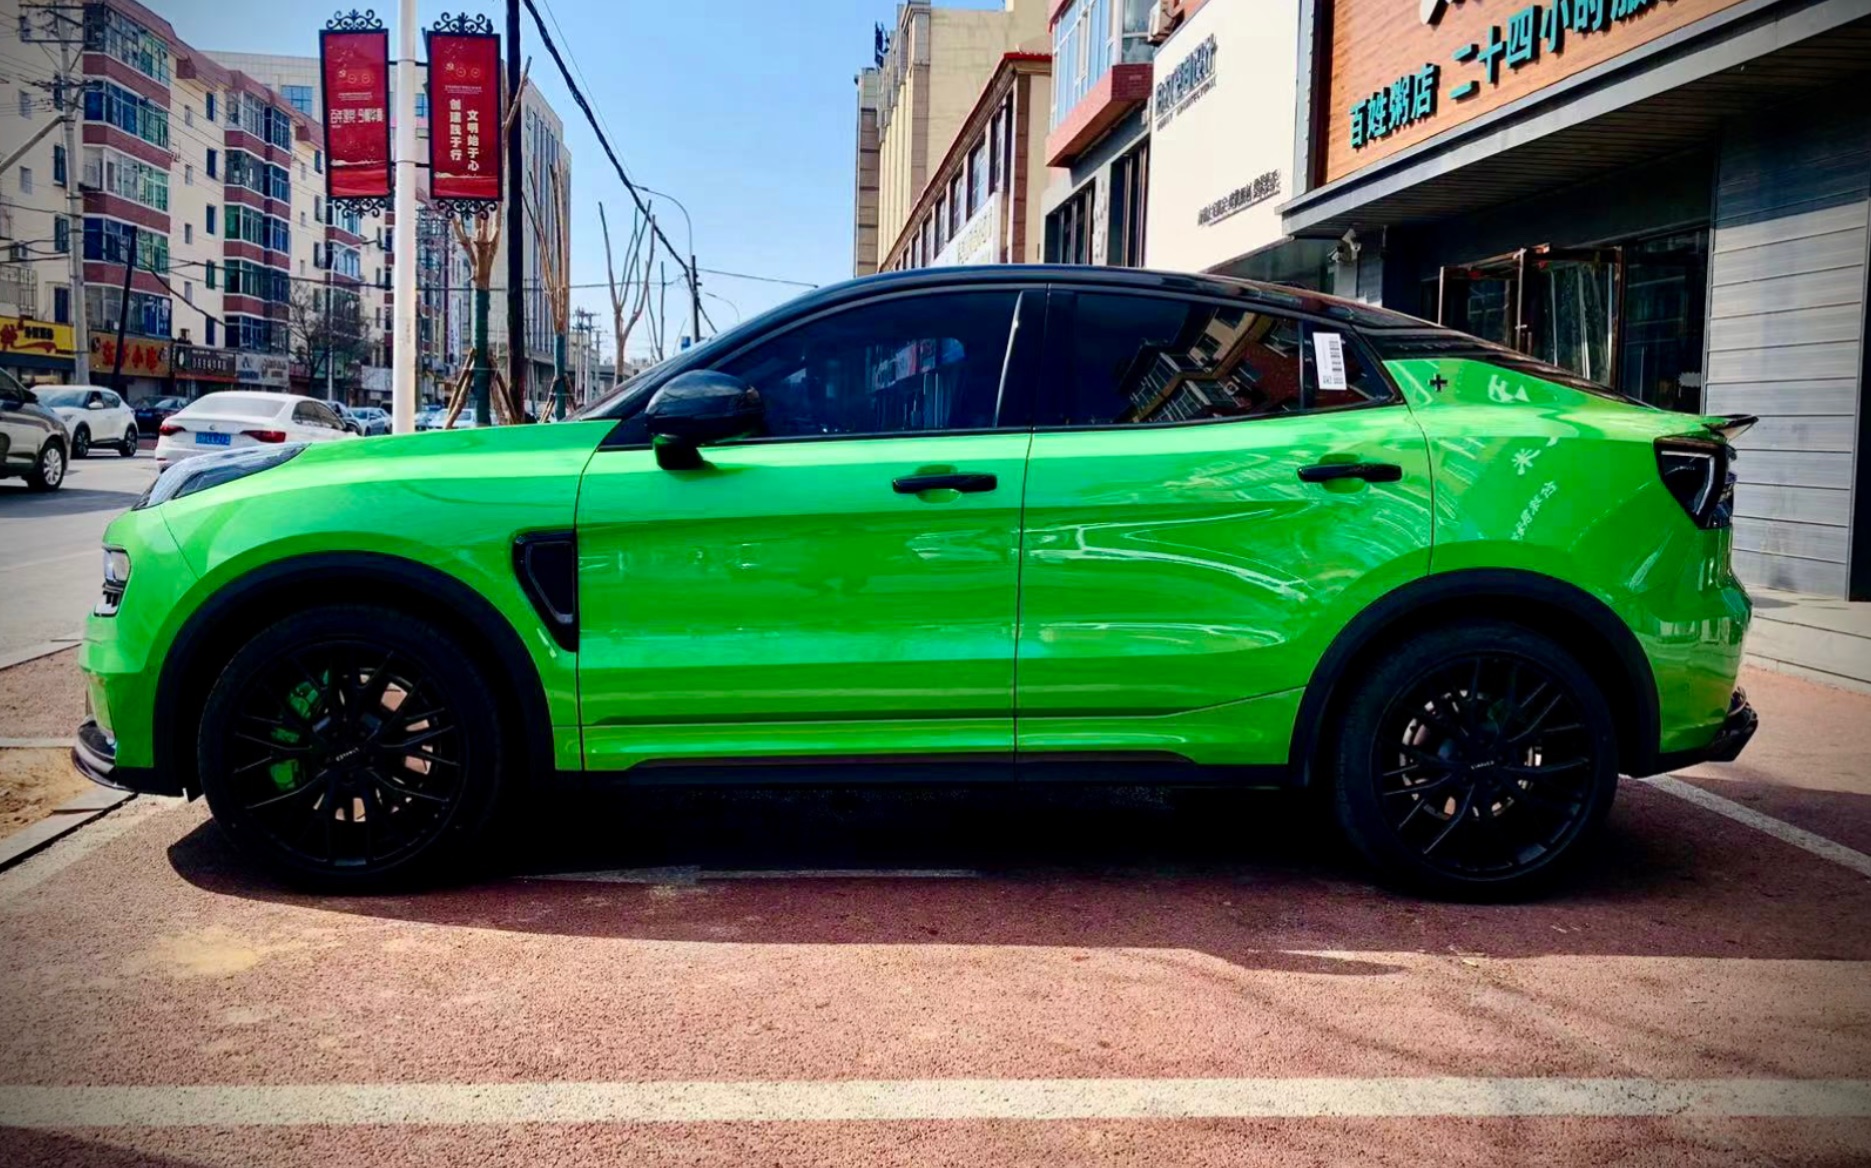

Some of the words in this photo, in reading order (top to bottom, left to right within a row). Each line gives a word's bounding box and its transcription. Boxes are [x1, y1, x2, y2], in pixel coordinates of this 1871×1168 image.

[467, 109, 480, 172] 文明始于心
[1349, 64, 1436, 147] 百姓粥店
